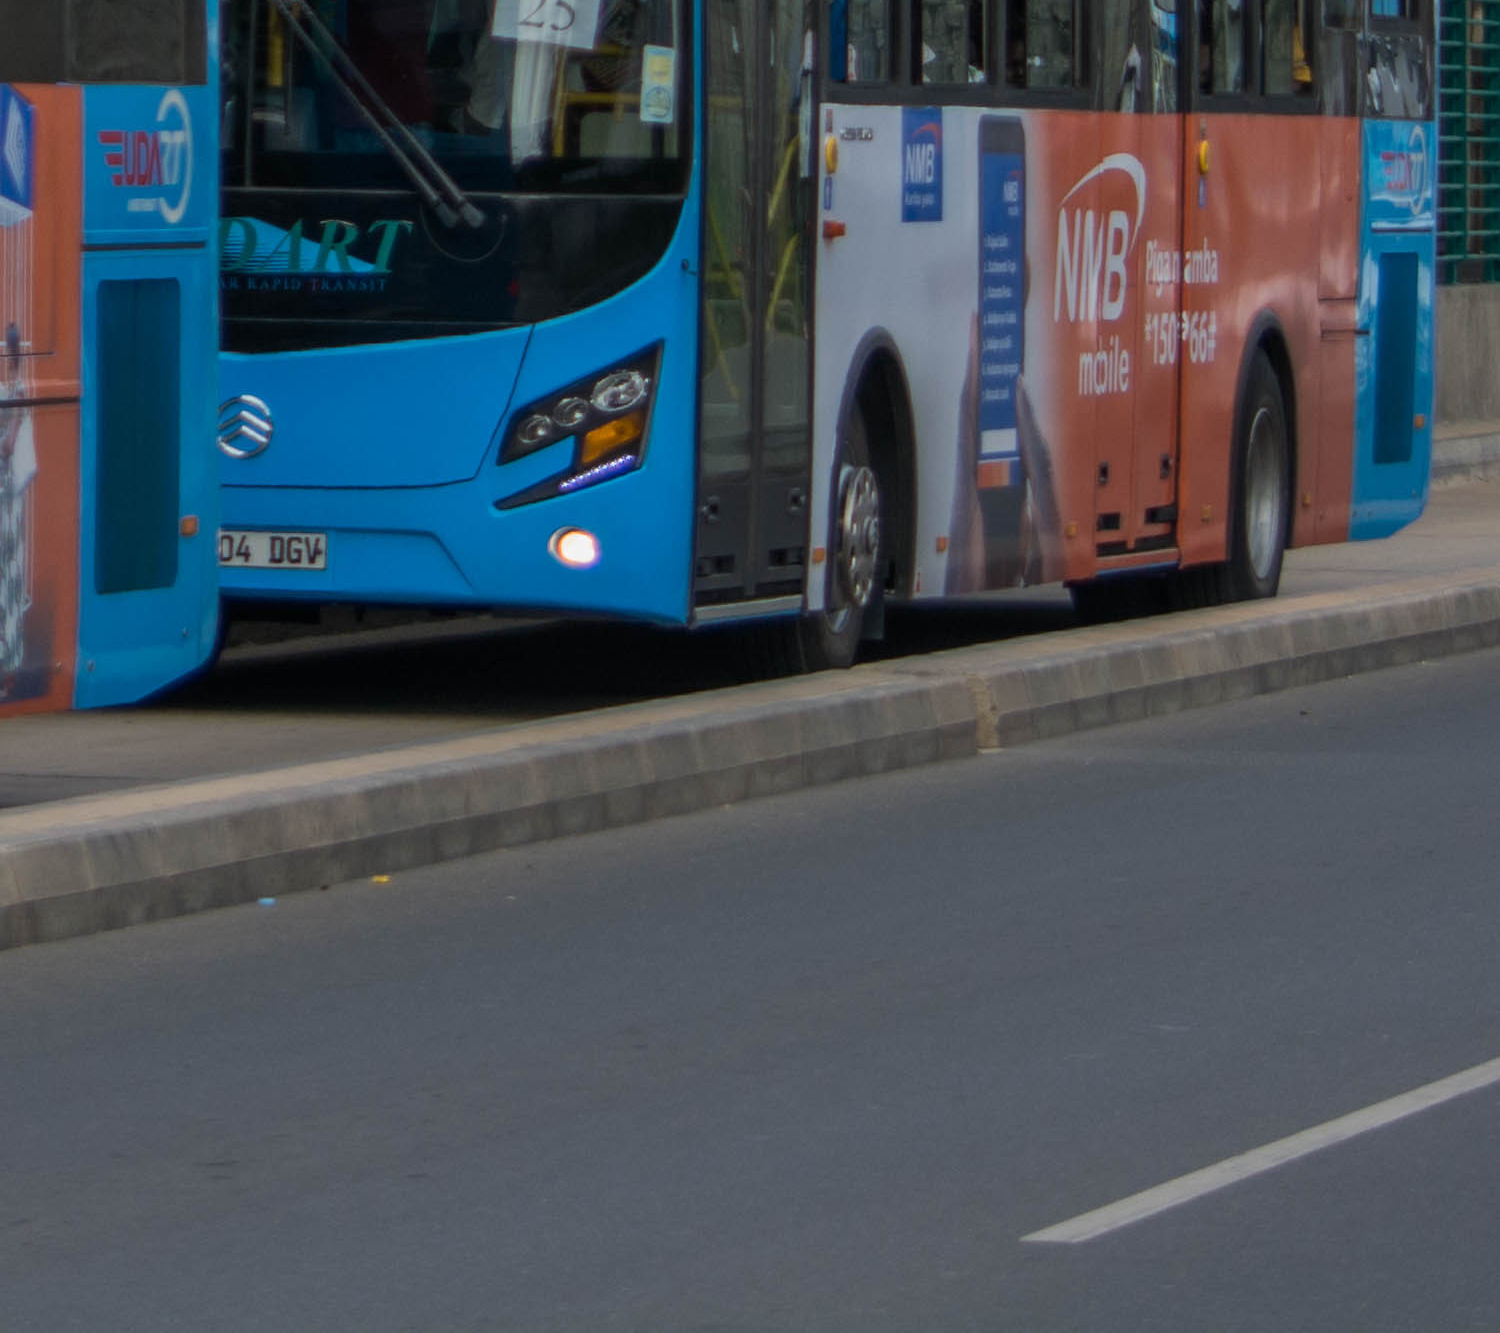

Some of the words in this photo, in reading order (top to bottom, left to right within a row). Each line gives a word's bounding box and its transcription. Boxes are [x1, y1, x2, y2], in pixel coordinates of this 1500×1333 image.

[904, 142, 936, 185] NMB
[218, 216, 415, 274] DART
[1145, 237, 1171, 297] Piga
[219, 534, 252, 563] 04
[268, 535, 322, 565] DGV
